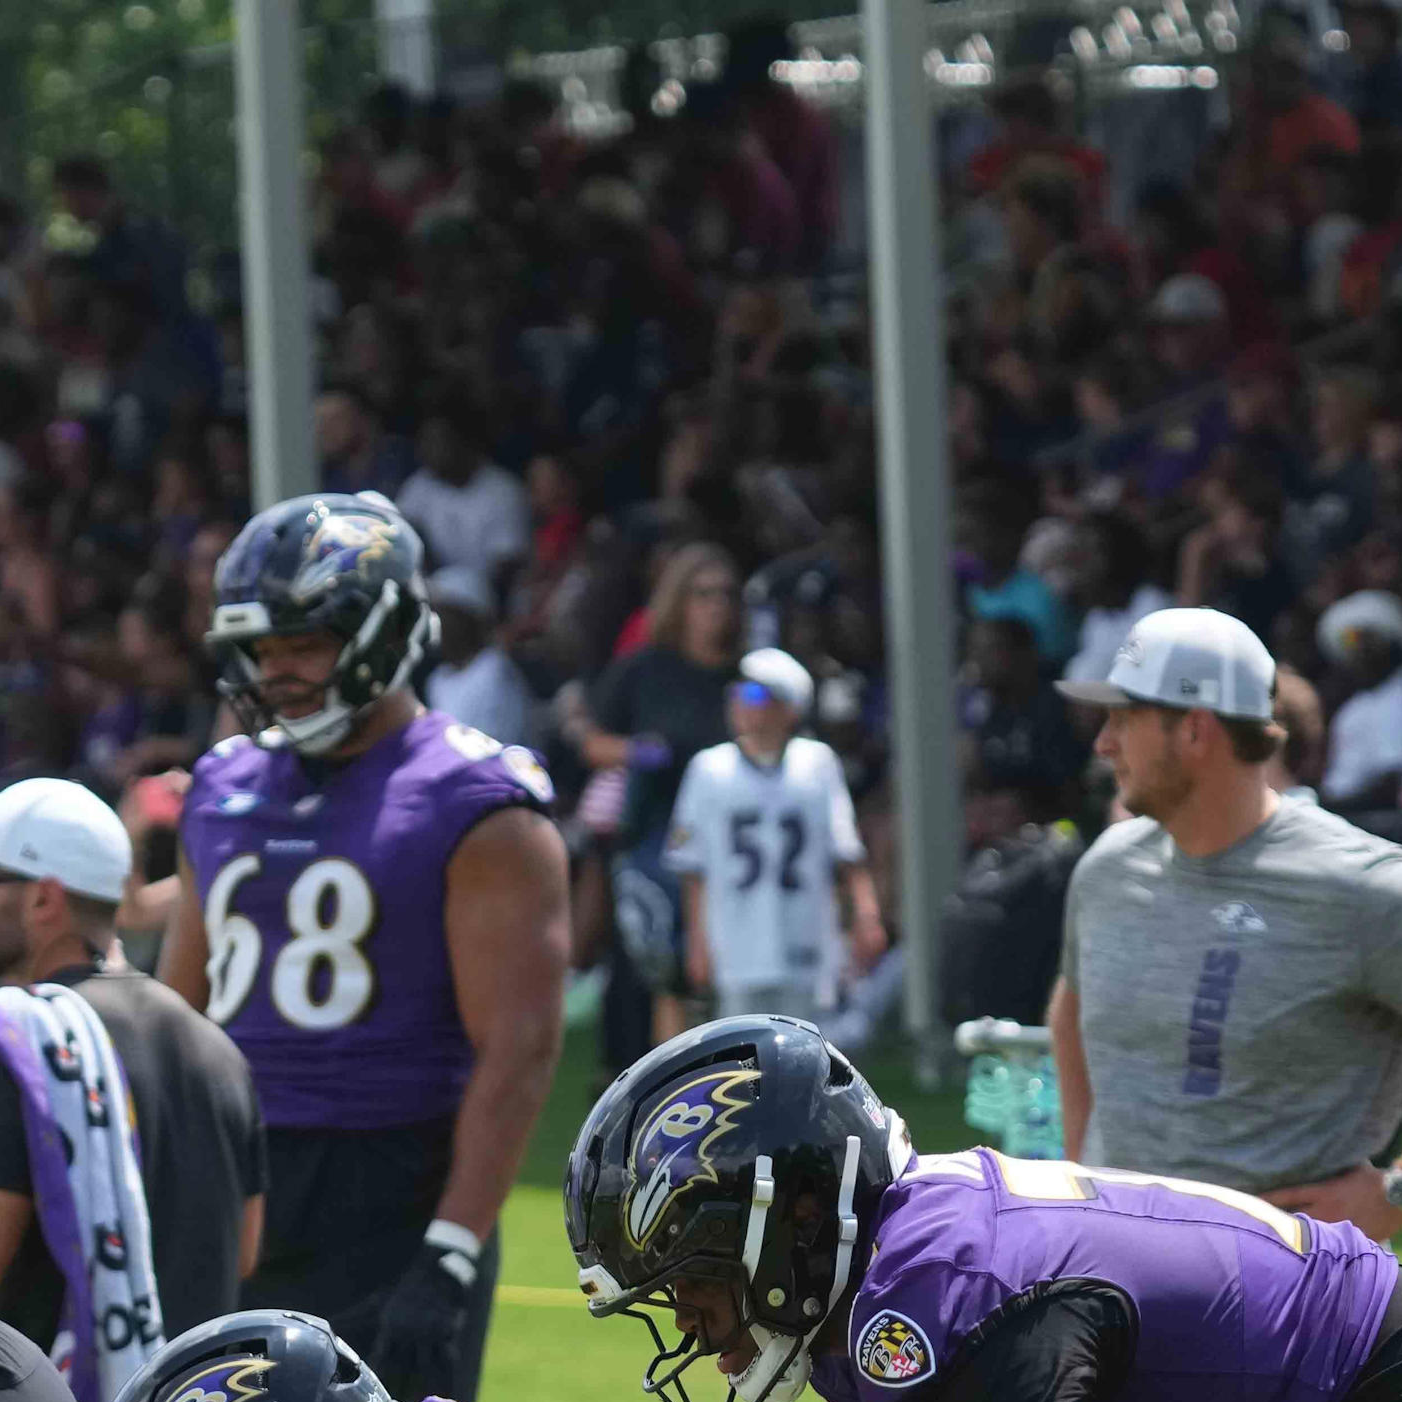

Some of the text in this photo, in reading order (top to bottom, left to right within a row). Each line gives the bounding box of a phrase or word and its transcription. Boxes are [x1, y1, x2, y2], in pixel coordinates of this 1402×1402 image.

[728, 809, 806, 891] 52
[204, 854, 376, 1030] 68
[860, 1316, 890, 1368] RAVENS
